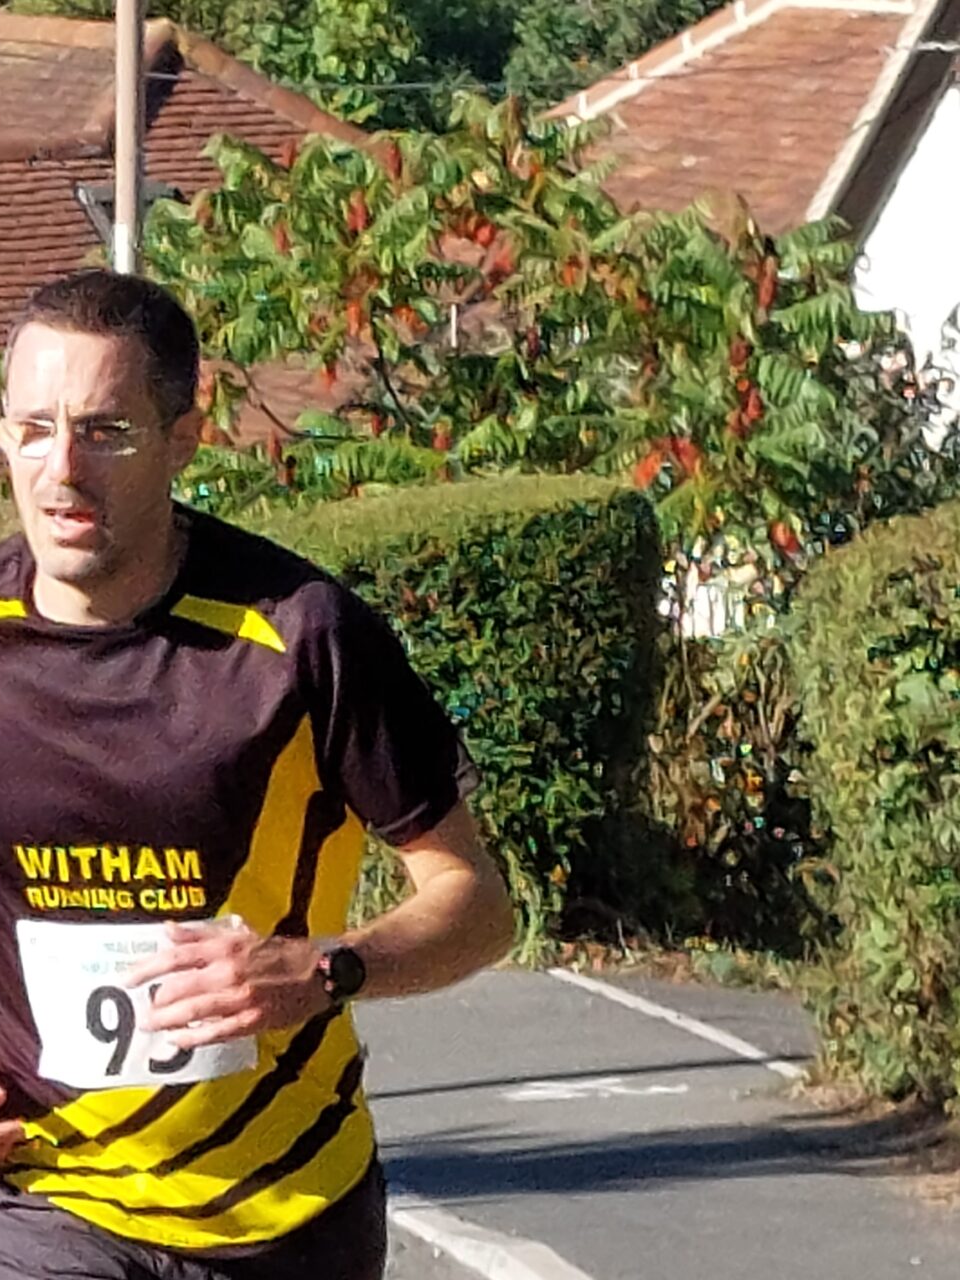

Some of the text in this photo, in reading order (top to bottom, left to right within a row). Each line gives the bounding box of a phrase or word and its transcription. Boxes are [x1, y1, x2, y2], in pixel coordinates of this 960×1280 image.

[15, 845, 202, 882] WITHAM
[26, 886, 206, 910] RUNNING CLUB
